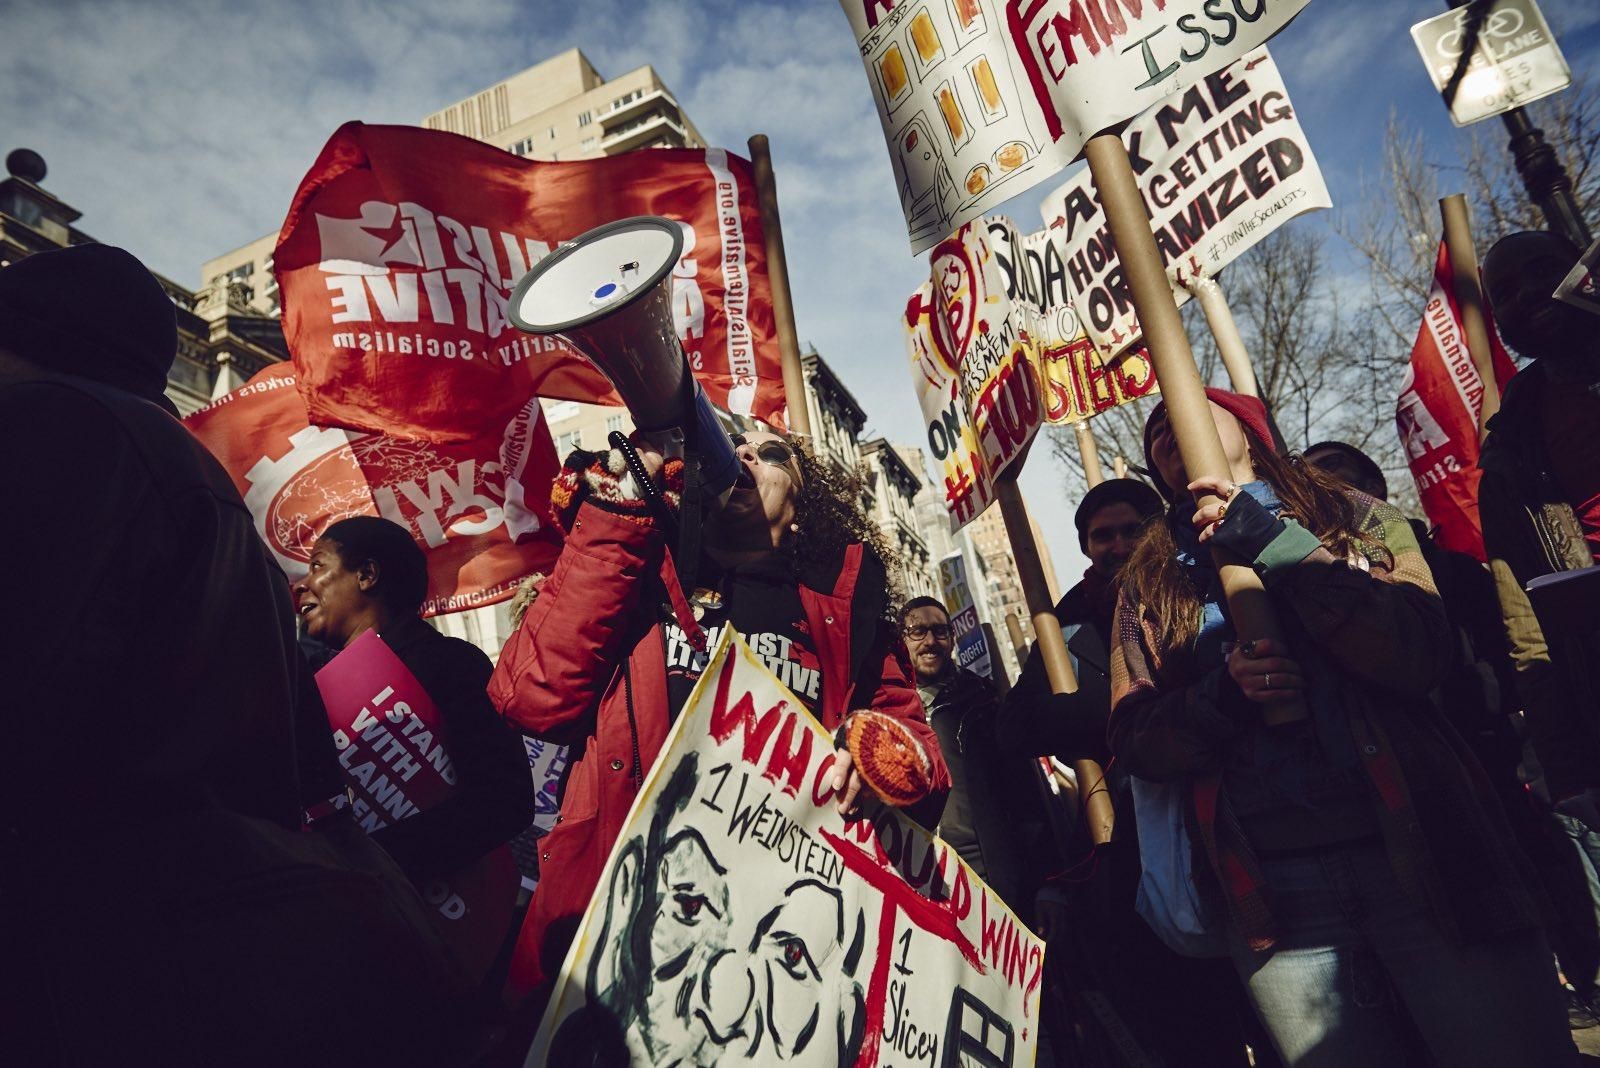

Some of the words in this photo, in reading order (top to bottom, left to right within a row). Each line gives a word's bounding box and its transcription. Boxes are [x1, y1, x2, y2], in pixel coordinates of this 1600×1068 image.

[1495, 28, 1544, 61] LANE
[1066, 131, 1153, 244] AK
[1155, 58, 1251, 150] ME
[1149, 90, 1293, 209] GETTING
[1088, 137, 1305, 333] ORANIZED
[960, 639, 985, 667] RIGHT
[332, 728, 422, 821] PLANN
[350, 706, 422, 783] WITH
[371, 685, 395, 707] I
[384, 701, 458, 787] STAND
[700, 762, 733, 814] 1
[726, 771, 846, 887] WEINSTEIN
[894, 927, 914, 975] 1
[982, 886, 1043, 1043] WIN?
